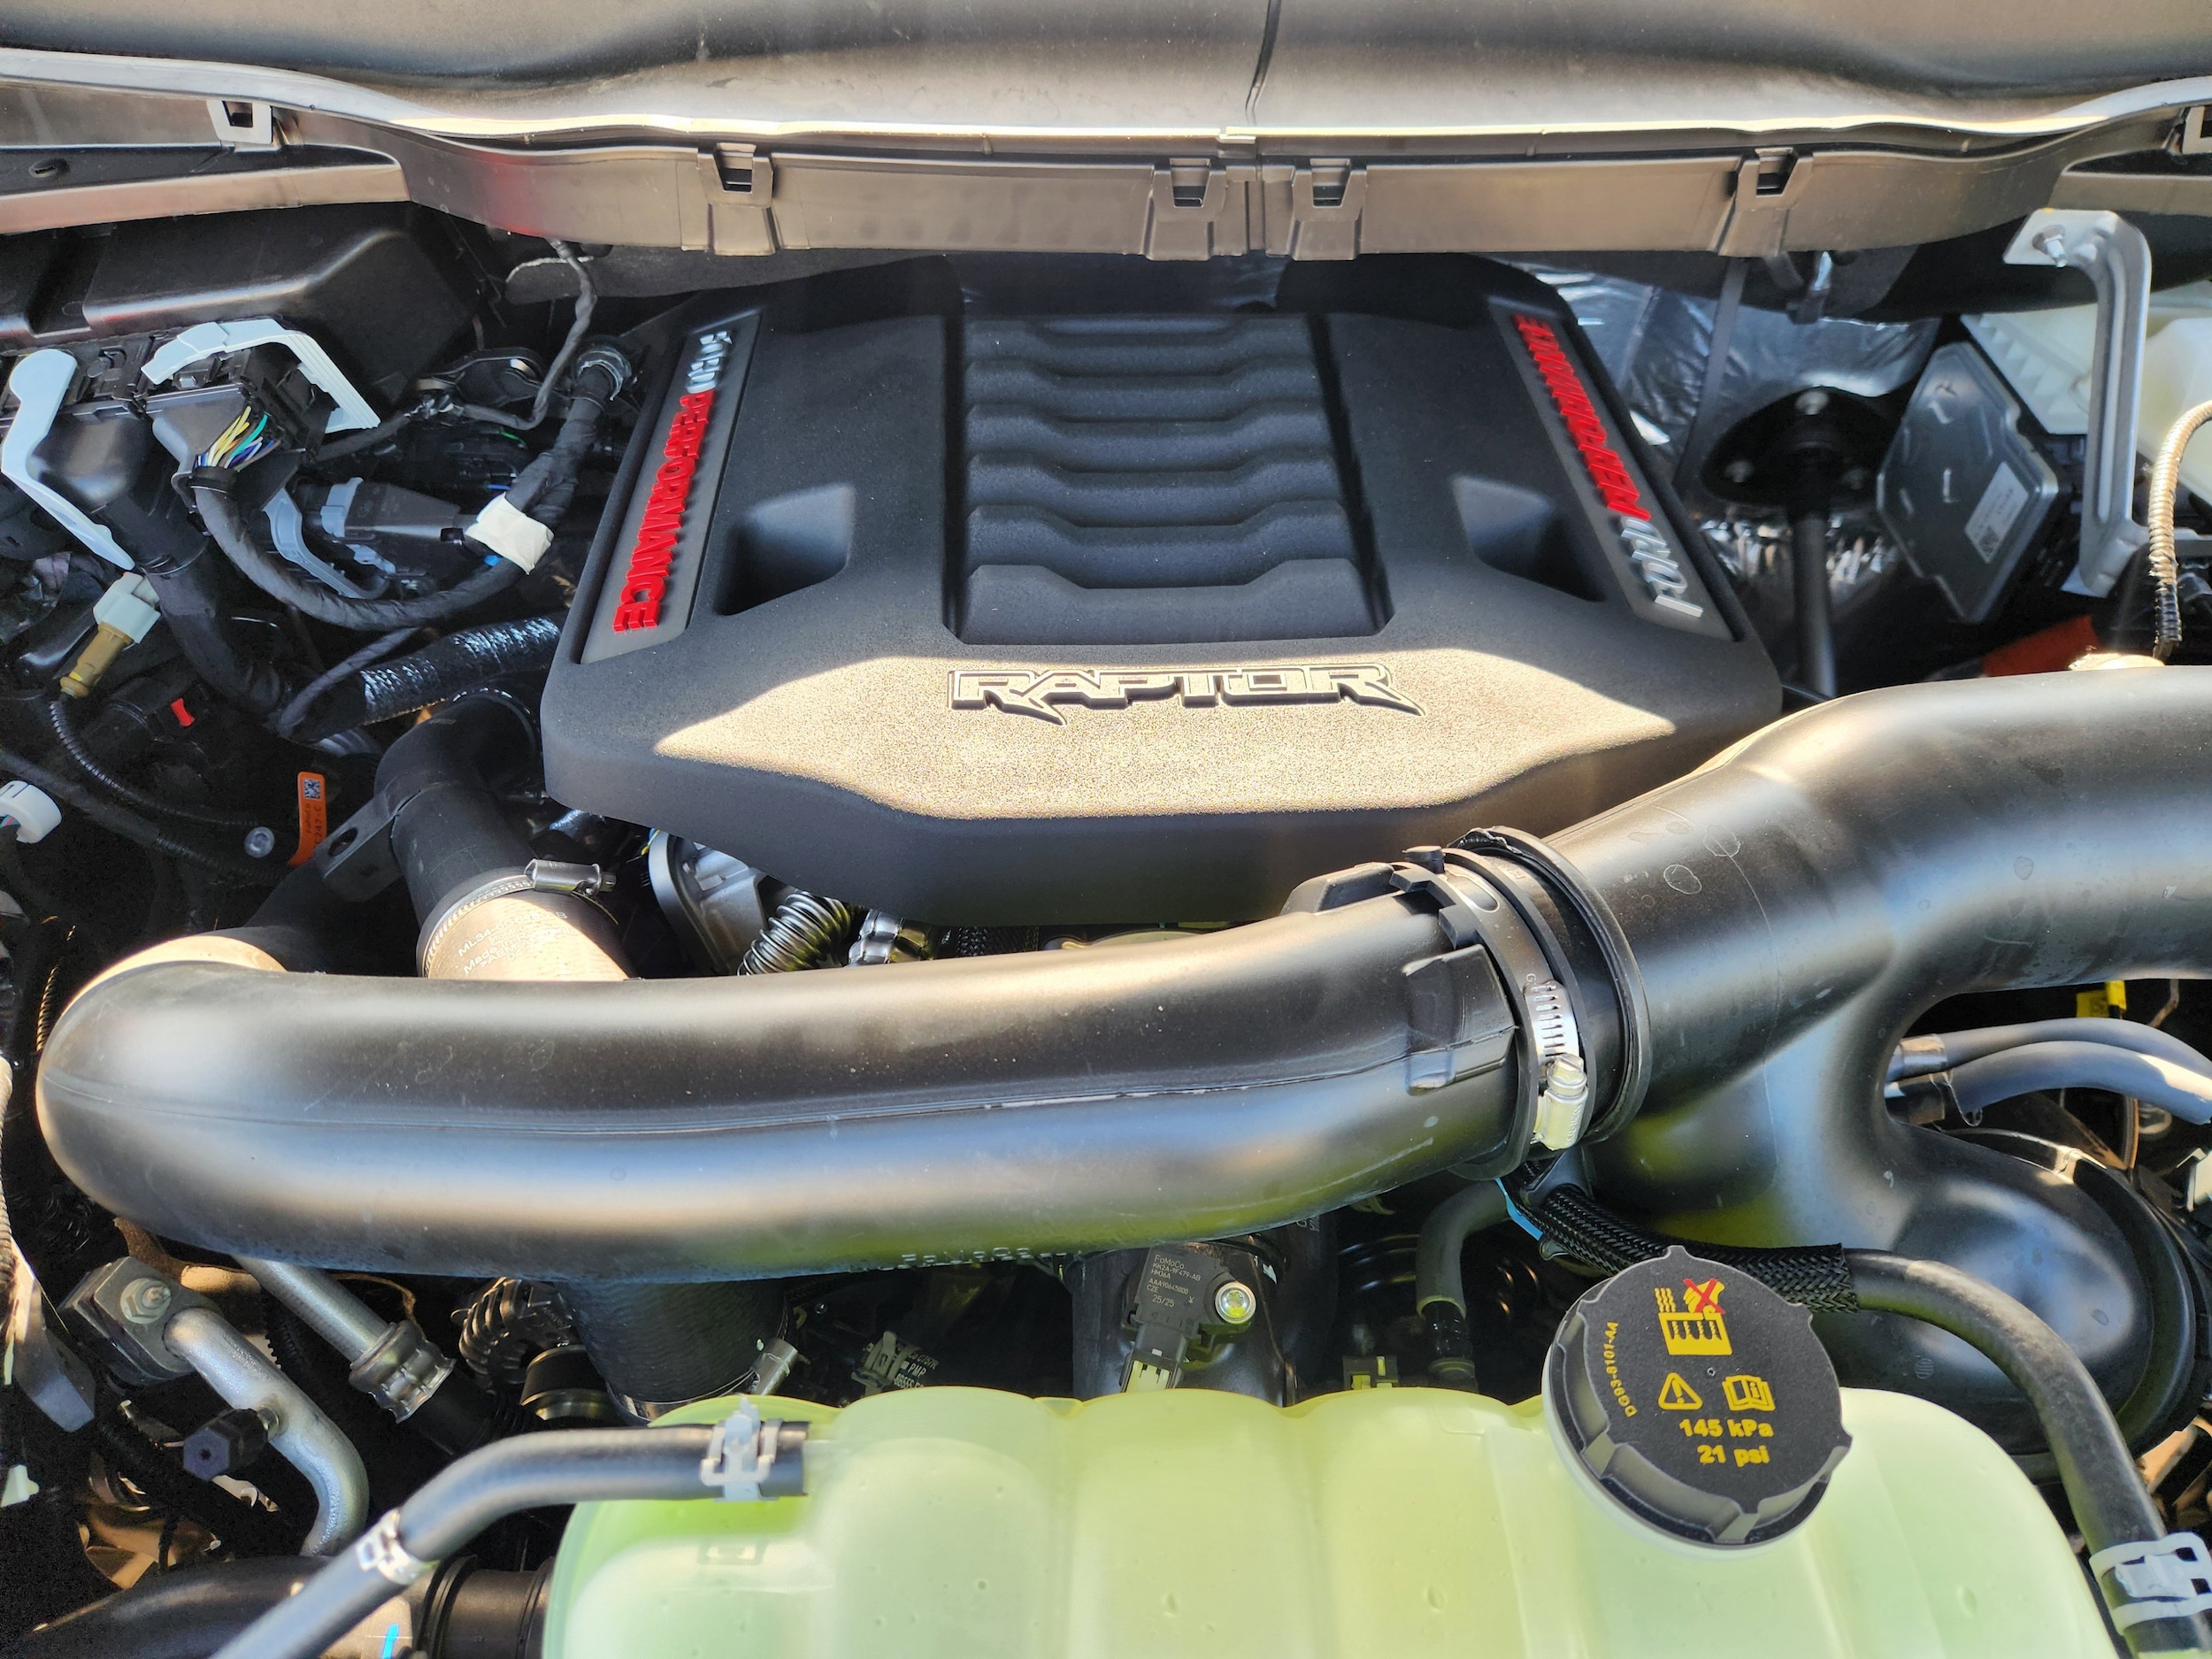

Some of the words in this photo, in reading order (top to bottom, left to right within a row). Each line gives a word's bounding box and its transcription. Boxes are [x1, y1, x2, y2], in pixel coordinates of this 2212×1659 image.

[685, 330, 733, 394] FORD
[1514, 313, 1652, 521] PERFORMANCE
[612, 389, 715, 634] PERFORMANCE
[1620, 517, 1704, 618] FORD
[948, 664, 1426, 726] RAPTOR
[464, 946, 498, 974] Made
[1155, 1254, 1185, 1270] FoMoCo
[1152, 1294, 1175, 1308] 25/25
[908, 1363, 926, 1378] PMP
[1679, 1418, 1724, 1438] 145
[1727, 1418, 1774, 1438] kPa
[1697, 1444, 1726, 1464] 21
[1734, 1445, 1770, 1468] psi
